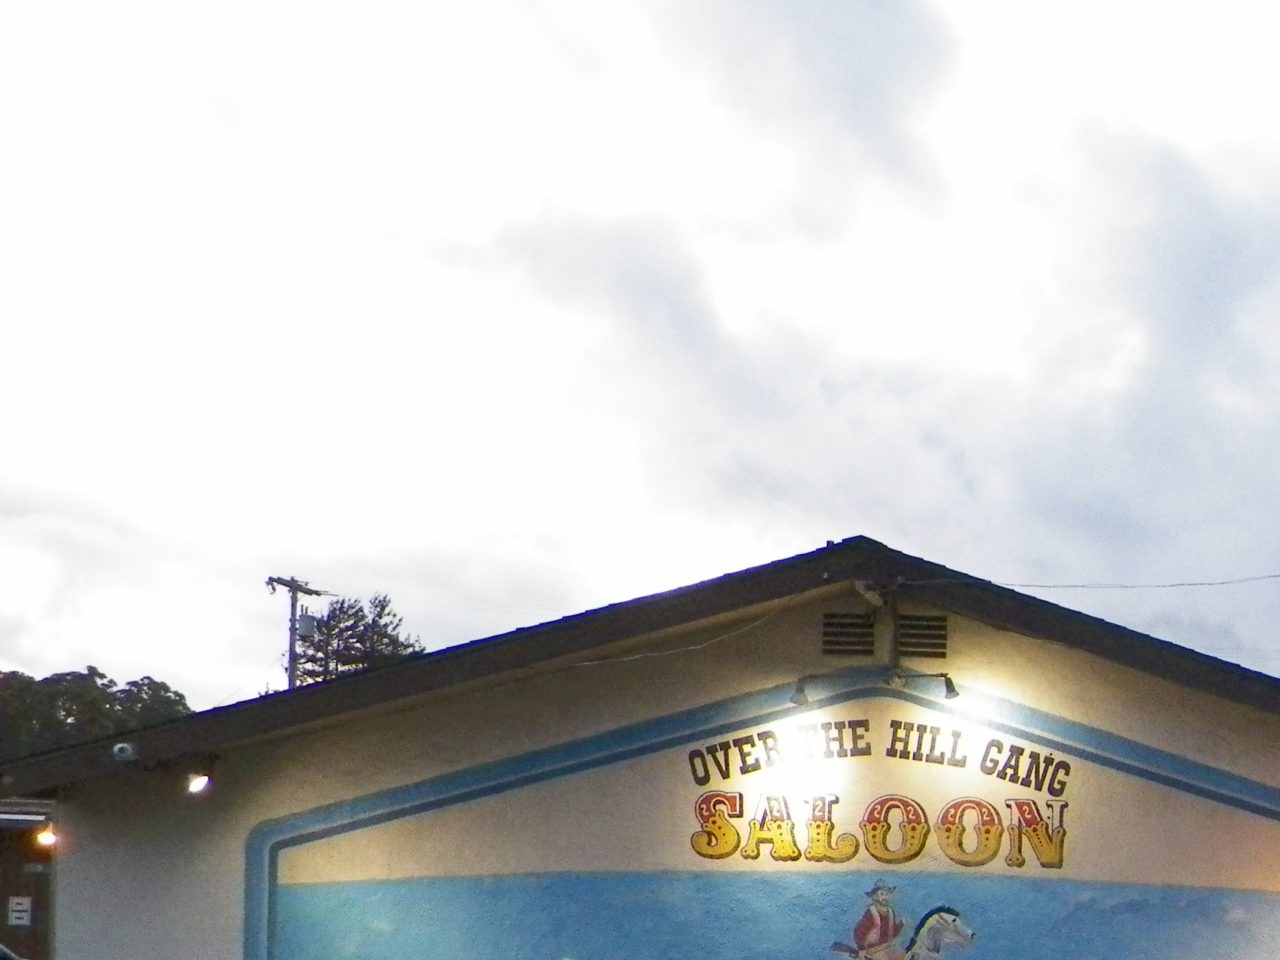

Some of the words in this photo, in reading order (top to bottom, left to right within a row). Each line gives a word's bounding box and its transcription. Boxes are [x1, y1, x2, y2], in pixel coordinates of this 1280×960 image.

[687, 730, 780, 787] OVER
[886, 719, 968, 768] HILL
[980, 738, 1072, 798] GANG
[690, 789, 1069, 869] SALOON
